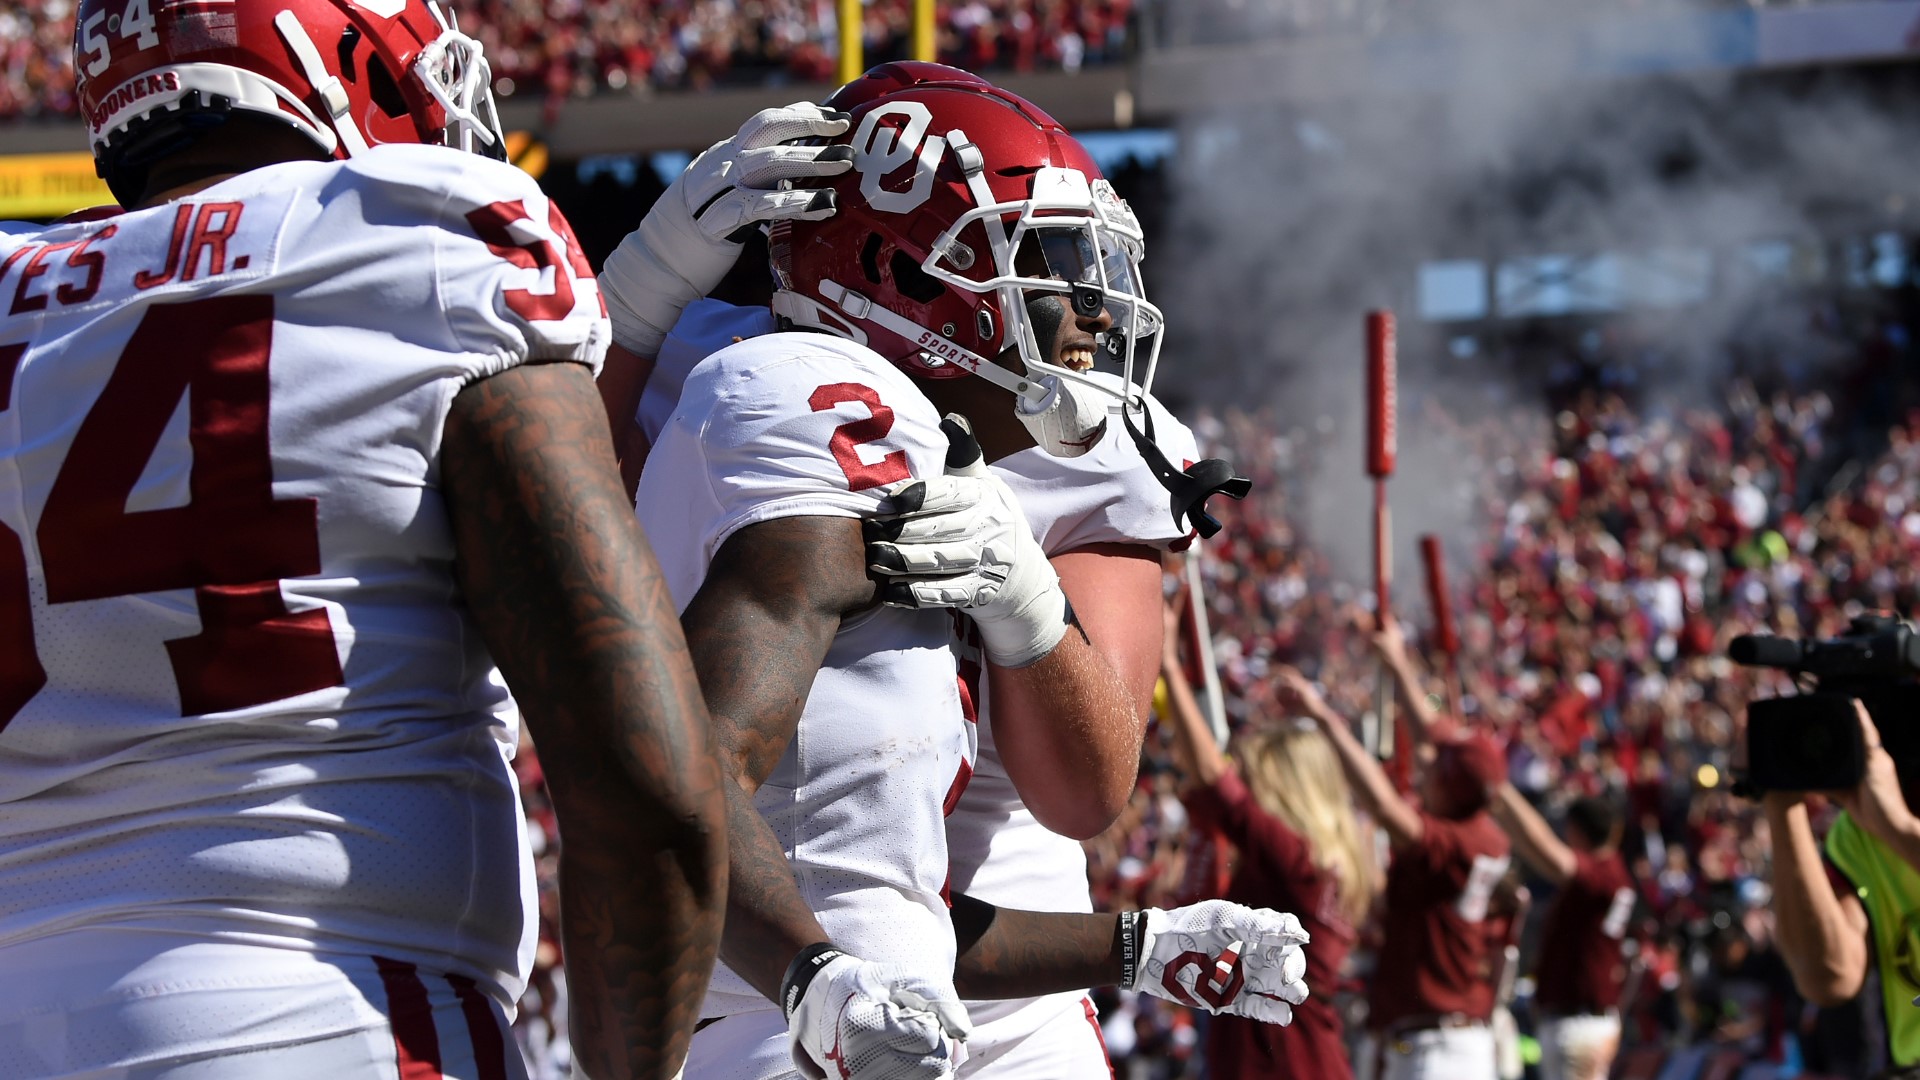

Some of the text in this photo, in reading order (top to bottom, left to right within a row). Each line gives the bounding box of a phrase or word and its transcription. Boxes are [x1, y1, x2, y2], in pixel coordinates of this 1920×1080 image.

[92, 71, 180, 134] SOONERS
[850, 101, 947, 214] OU
[134, 201, 250, 290] JR.
[808, 382, 911, 492] 2
[1123, 933, 1133, 960] OVER
[1124, 964, 1133, 986] HYPE
